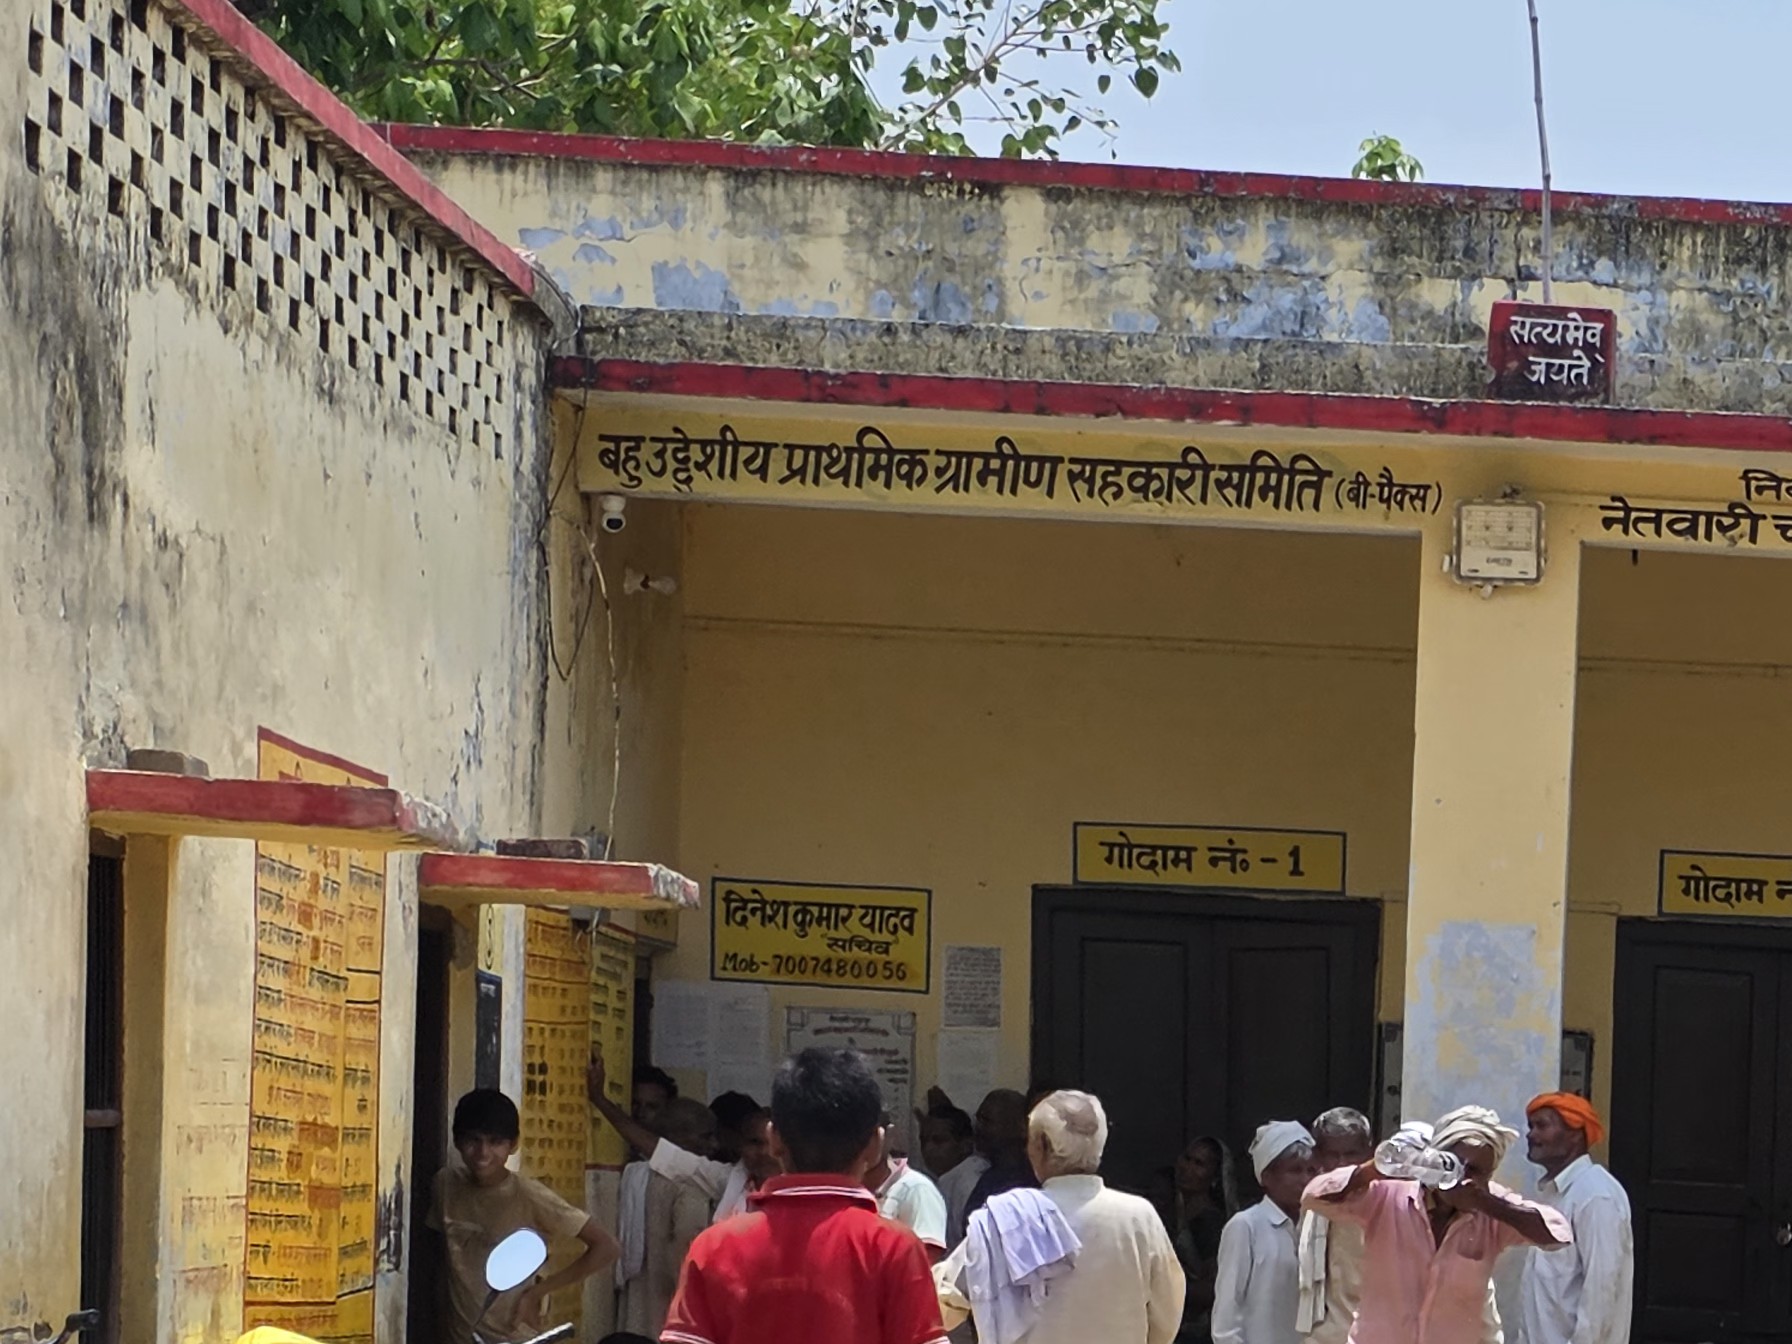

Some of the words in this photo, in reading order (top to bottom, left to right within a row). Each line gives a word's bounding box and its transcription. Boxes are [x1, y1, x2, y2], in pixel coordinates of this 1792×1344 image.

[1524, 349, 1592, 387] जयते
[777, 426, 930, 490] प्राथमिक
[933, 436, 1065, 500] ग्रामीण
[1066, 446, 1214, 507] सहकारी
[1214, 450, 1334, 512] समिति
[1599, 495, 1767, 546] नेतवारी
[1099, 831, 1198, 876] गोदाम
[1677, 864, 1769, 909] गोदाम
[722, 888, 791, 932] दिनेश
[791, 901, 855, 940] कुमार
[860, 904, 919, 937] यादव
